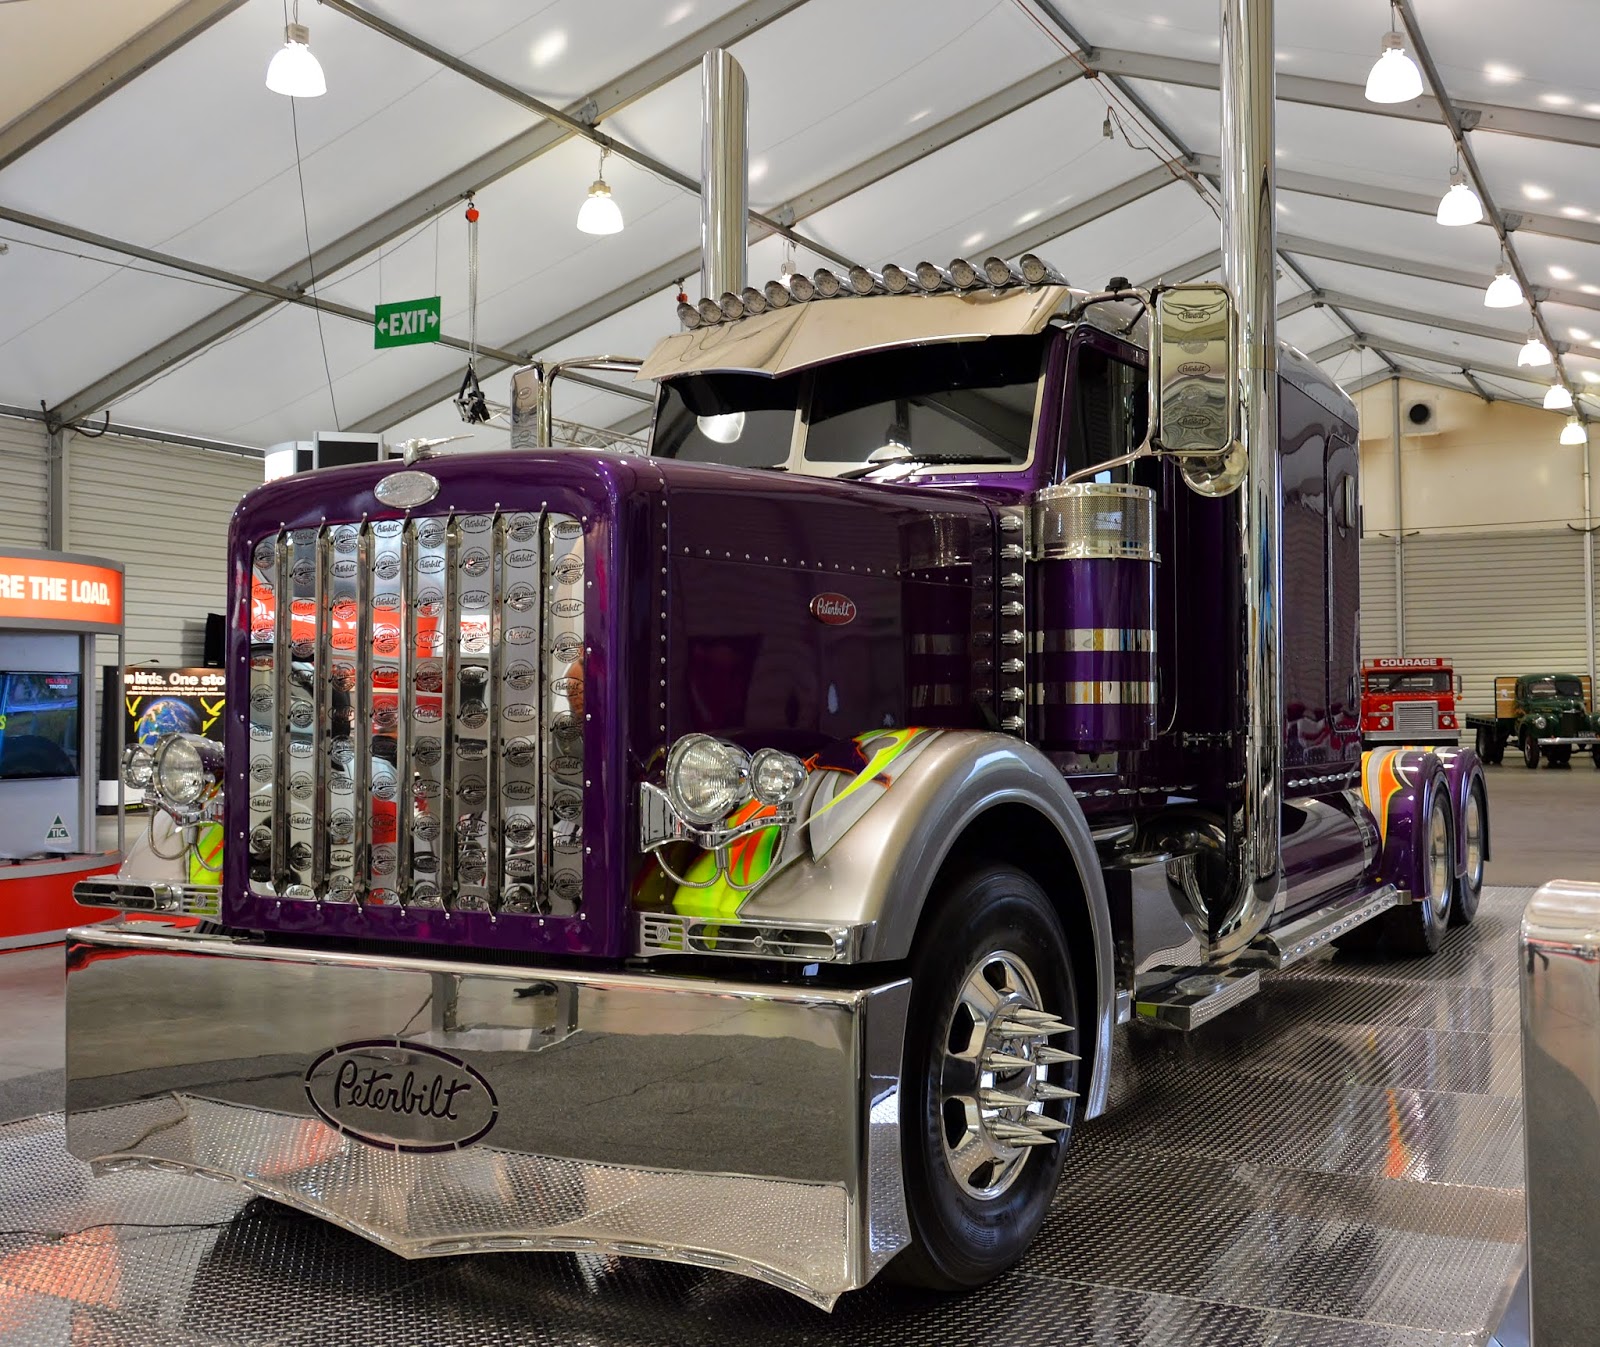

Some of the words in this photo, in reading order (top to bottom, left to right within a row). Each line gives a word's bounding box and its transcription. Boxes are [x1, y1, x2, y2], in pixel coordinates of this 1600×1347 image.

[390, 309, 428, 336] EXIT
[464, 519, 488, 528] Peterbilt
[510, 554, 534, 563] Peterbilt
[0, 574, 25, 599] RE
[28, 576, 67, 602] THE
[71, 579, 110, 606] LOAD.
[556, 604, 582, 612] Peterbilt
[817, 597, 852, 616] Peterbilt
[1380, 658, 1437, 667] COURAGE
[135, 672, 166, 685] birds.
[169, 673, 199, 685] One
[51, 828, 65, 838] TIC
[334, 1059, 472, 1120] Peterbilt
